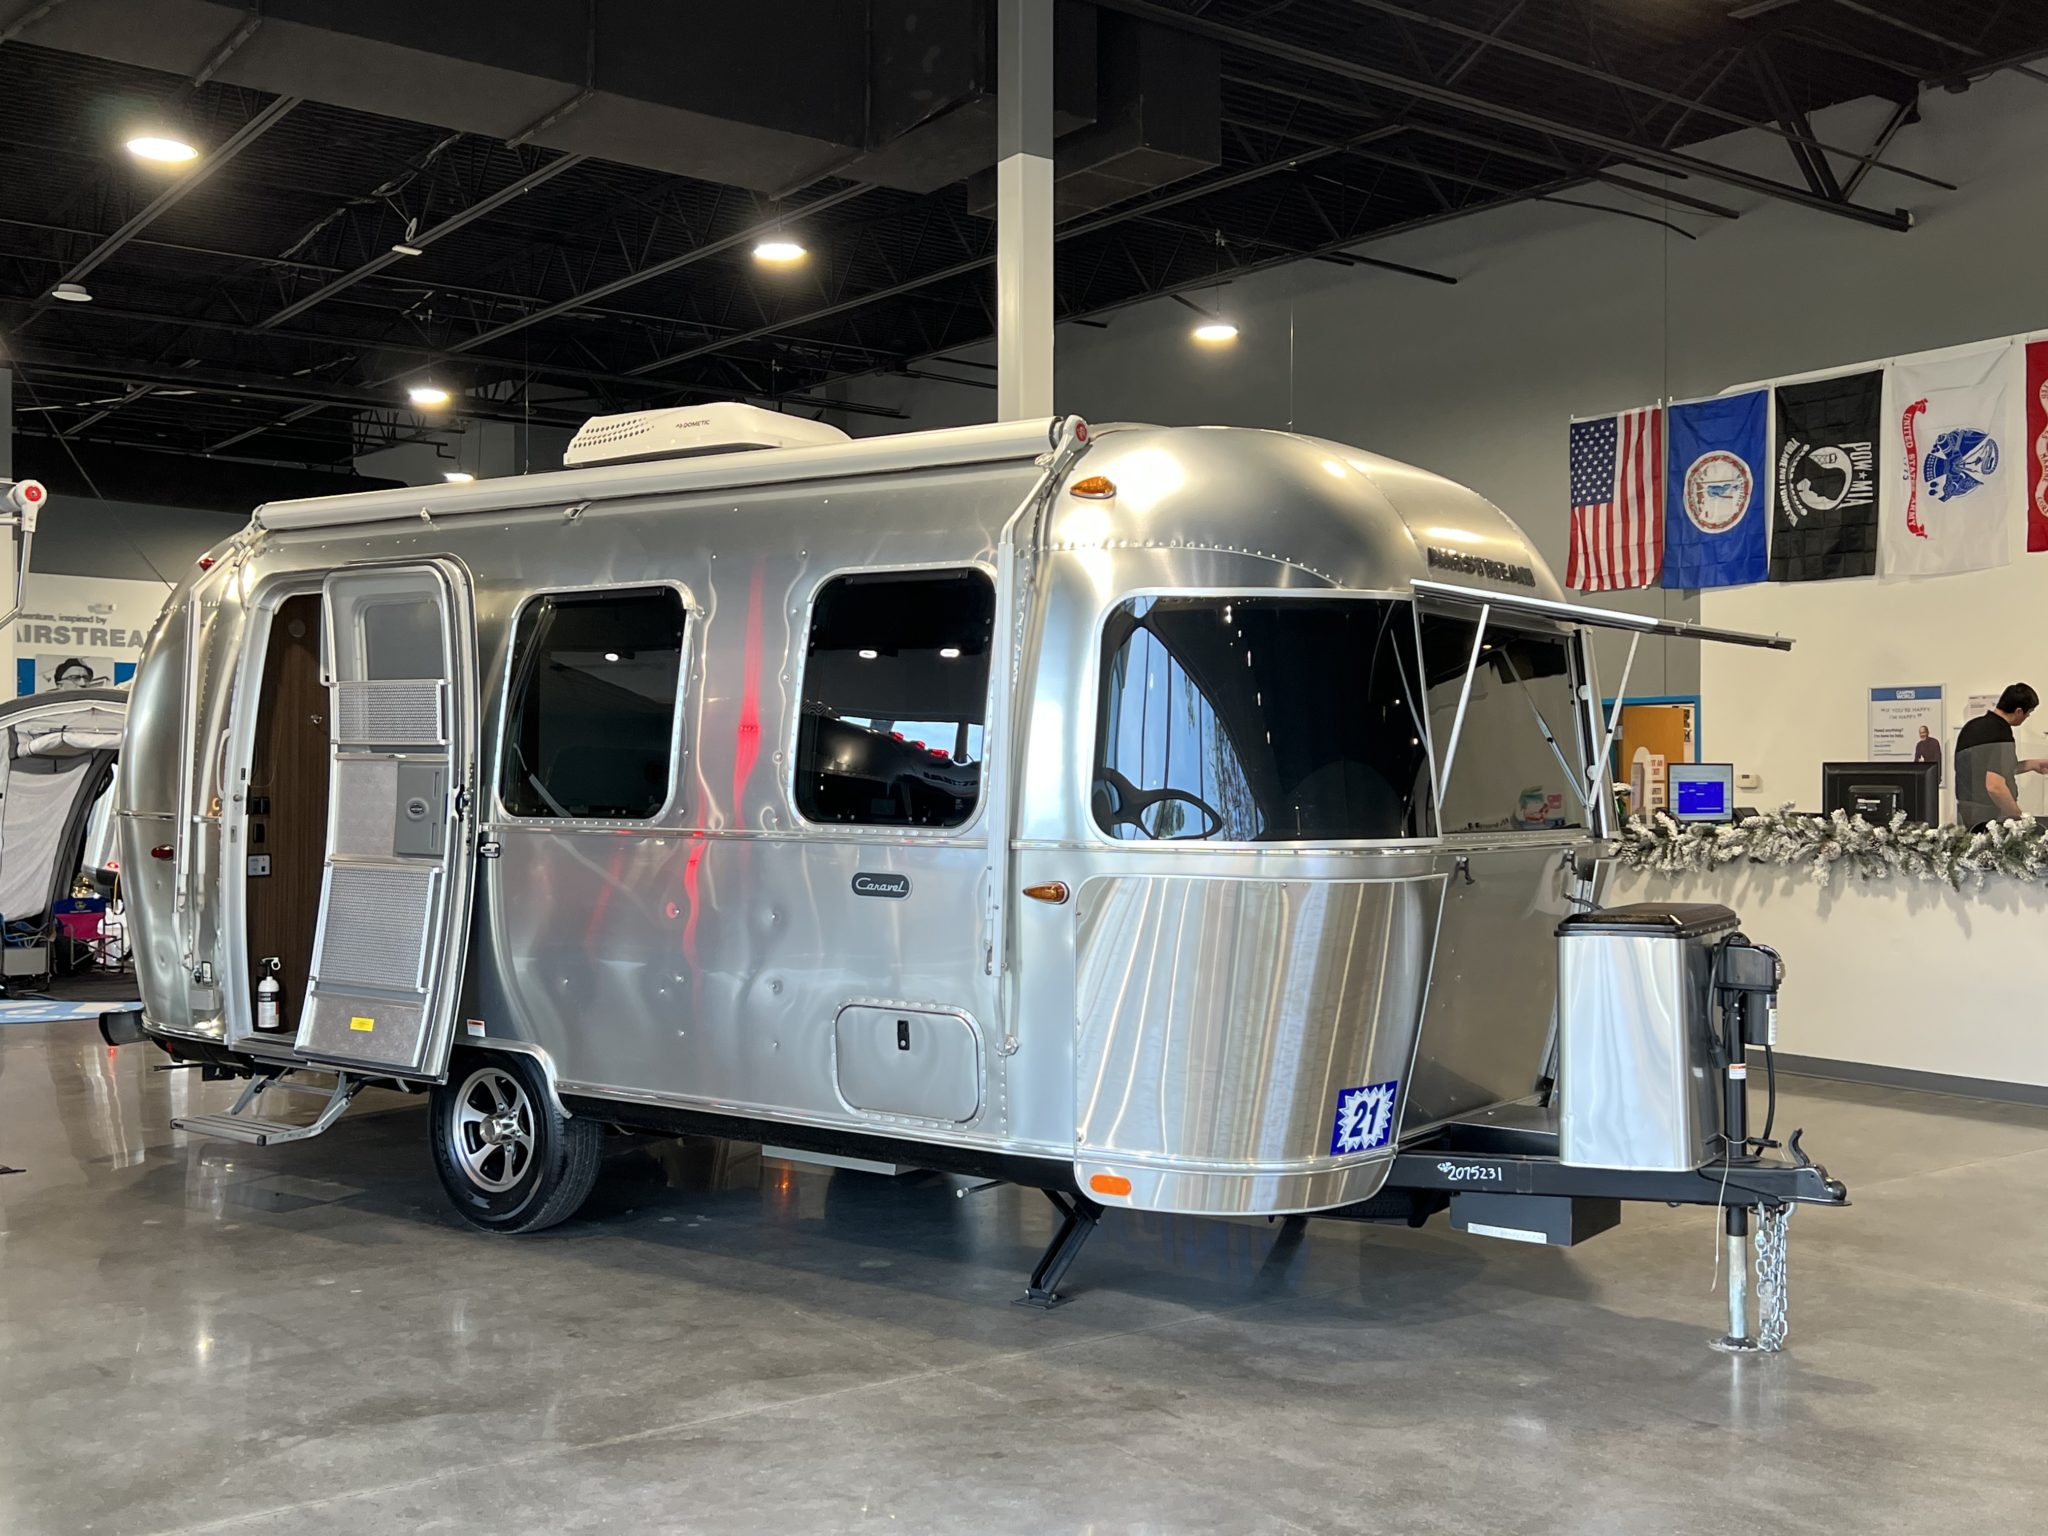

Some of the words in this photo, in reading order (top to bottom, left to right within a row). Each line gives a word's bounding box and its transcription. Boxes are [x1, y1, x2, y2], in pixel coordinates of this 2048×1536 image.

[683, 419, 710, 429] DOMETIC
[1903, 413, 1915, 449] UNITED
[1838, 441, 1872, 471] POW
[1779, 468, 1787, 484] NOT
[1835, 480, 1874, 511] MIA
[59, 613, 93, 623] inspired
[96, 615, 107, 625] by
[17, 624, 150, 648] IRSTREA
[856, 877, 904, 892] Caravel
[1349, 1098, 1380, 1138] 21
[1448, 1165, 1502, 1181] 2075231
